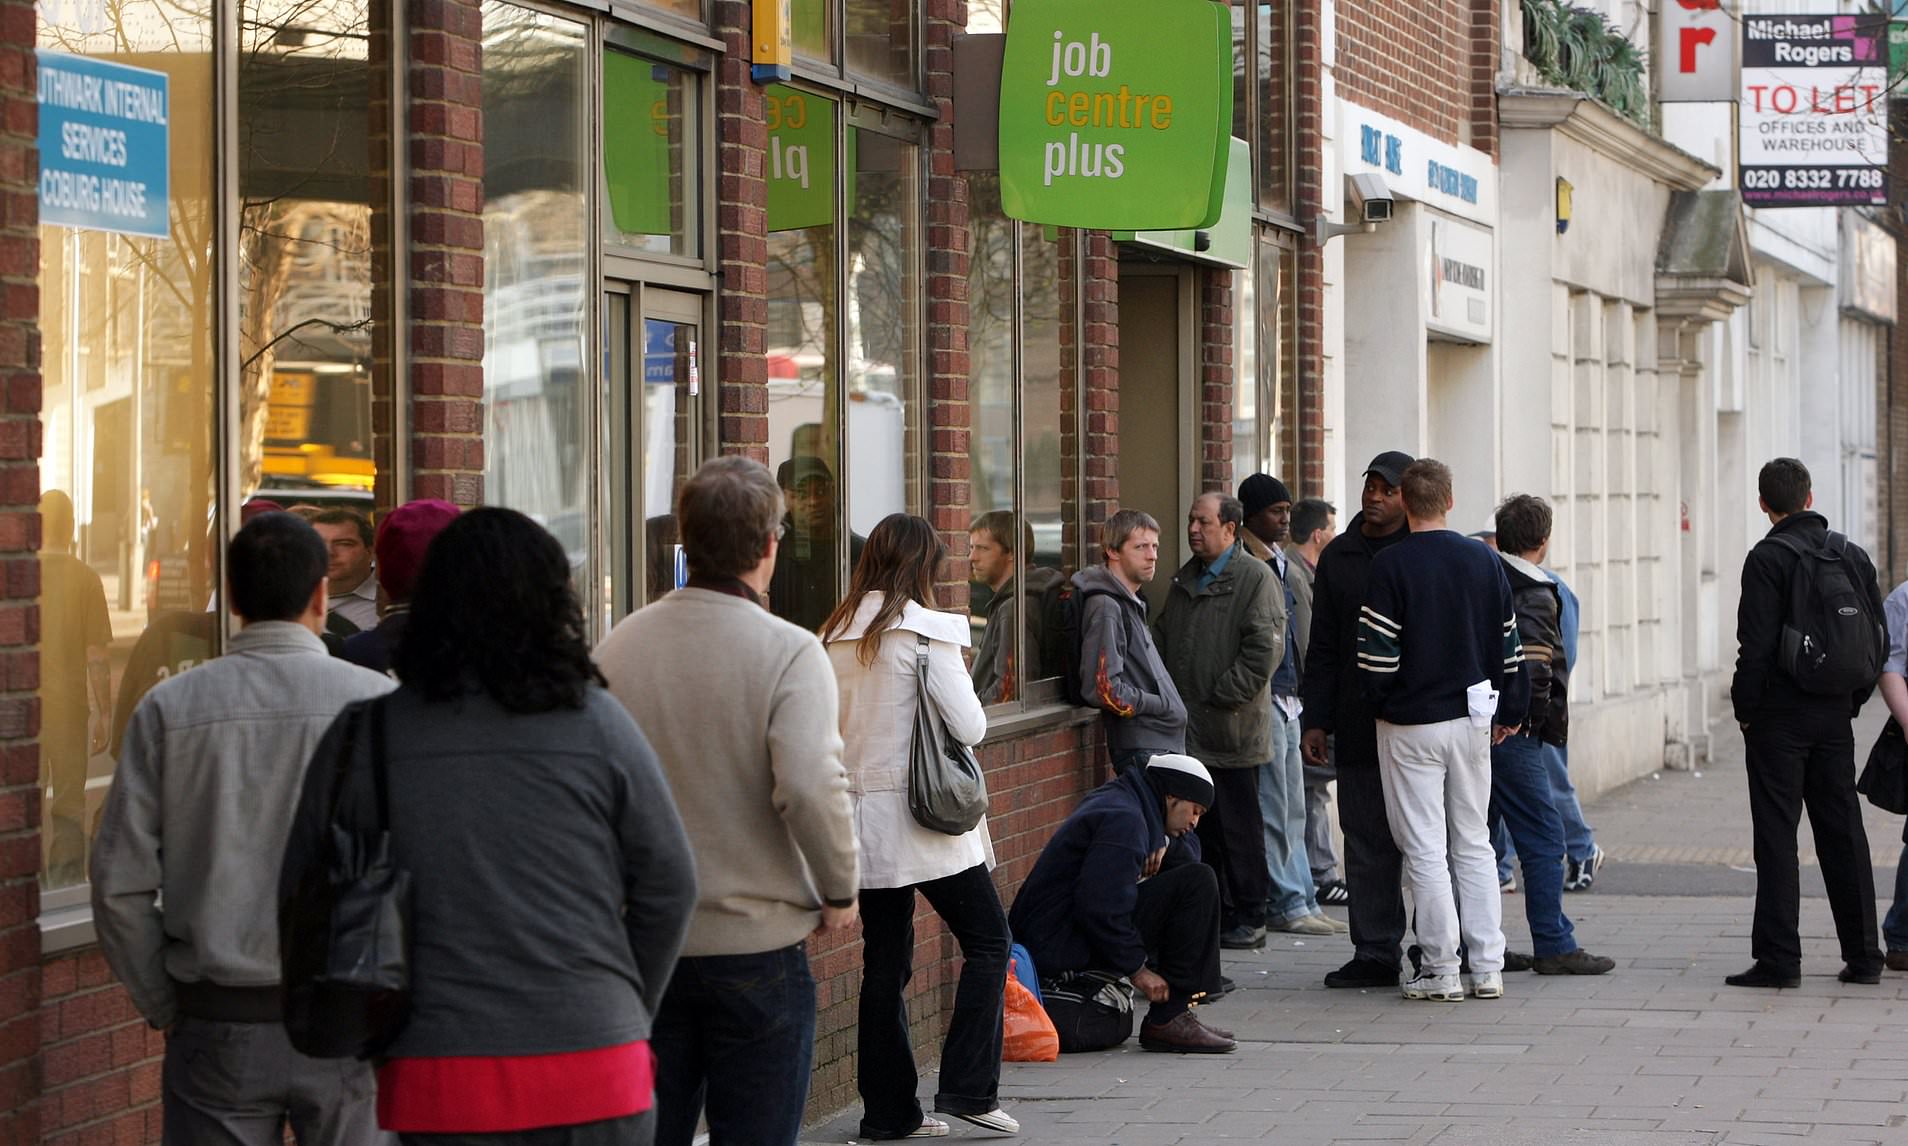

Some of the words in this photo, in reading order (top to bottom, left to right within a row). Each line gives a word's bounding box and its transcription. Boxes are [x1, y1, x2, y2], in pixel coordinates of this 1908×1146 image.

[1747, 19, 1831, 40] Michael
[1046, 30, 1111, 86] job
[1774, 42, 1852, 66] Rogers
[104, 79, 167, 126] INTERNAL
[1045, 84, 1173, 129] centre
[1747, 85, 1798, 114] TO
[1811, 85, 1879, 114] LET
[61, 120, 128, 168] SERVICES
[1759, 121, 1826, 135] OFFICES
[1832, 121, 1866, 135] AND
[1762, 138, 1866, 151] WAREHOUSE
[1043, 132, 1125, 186] plus
[41, 168, 100, 213] COBURG
[101, 178, 147, 218] HOUSE
[1744, 169, 1781, 188] 020
[1785, 169, 1832, 188] 8332
[1836, 169, 1883, 188] 7788
